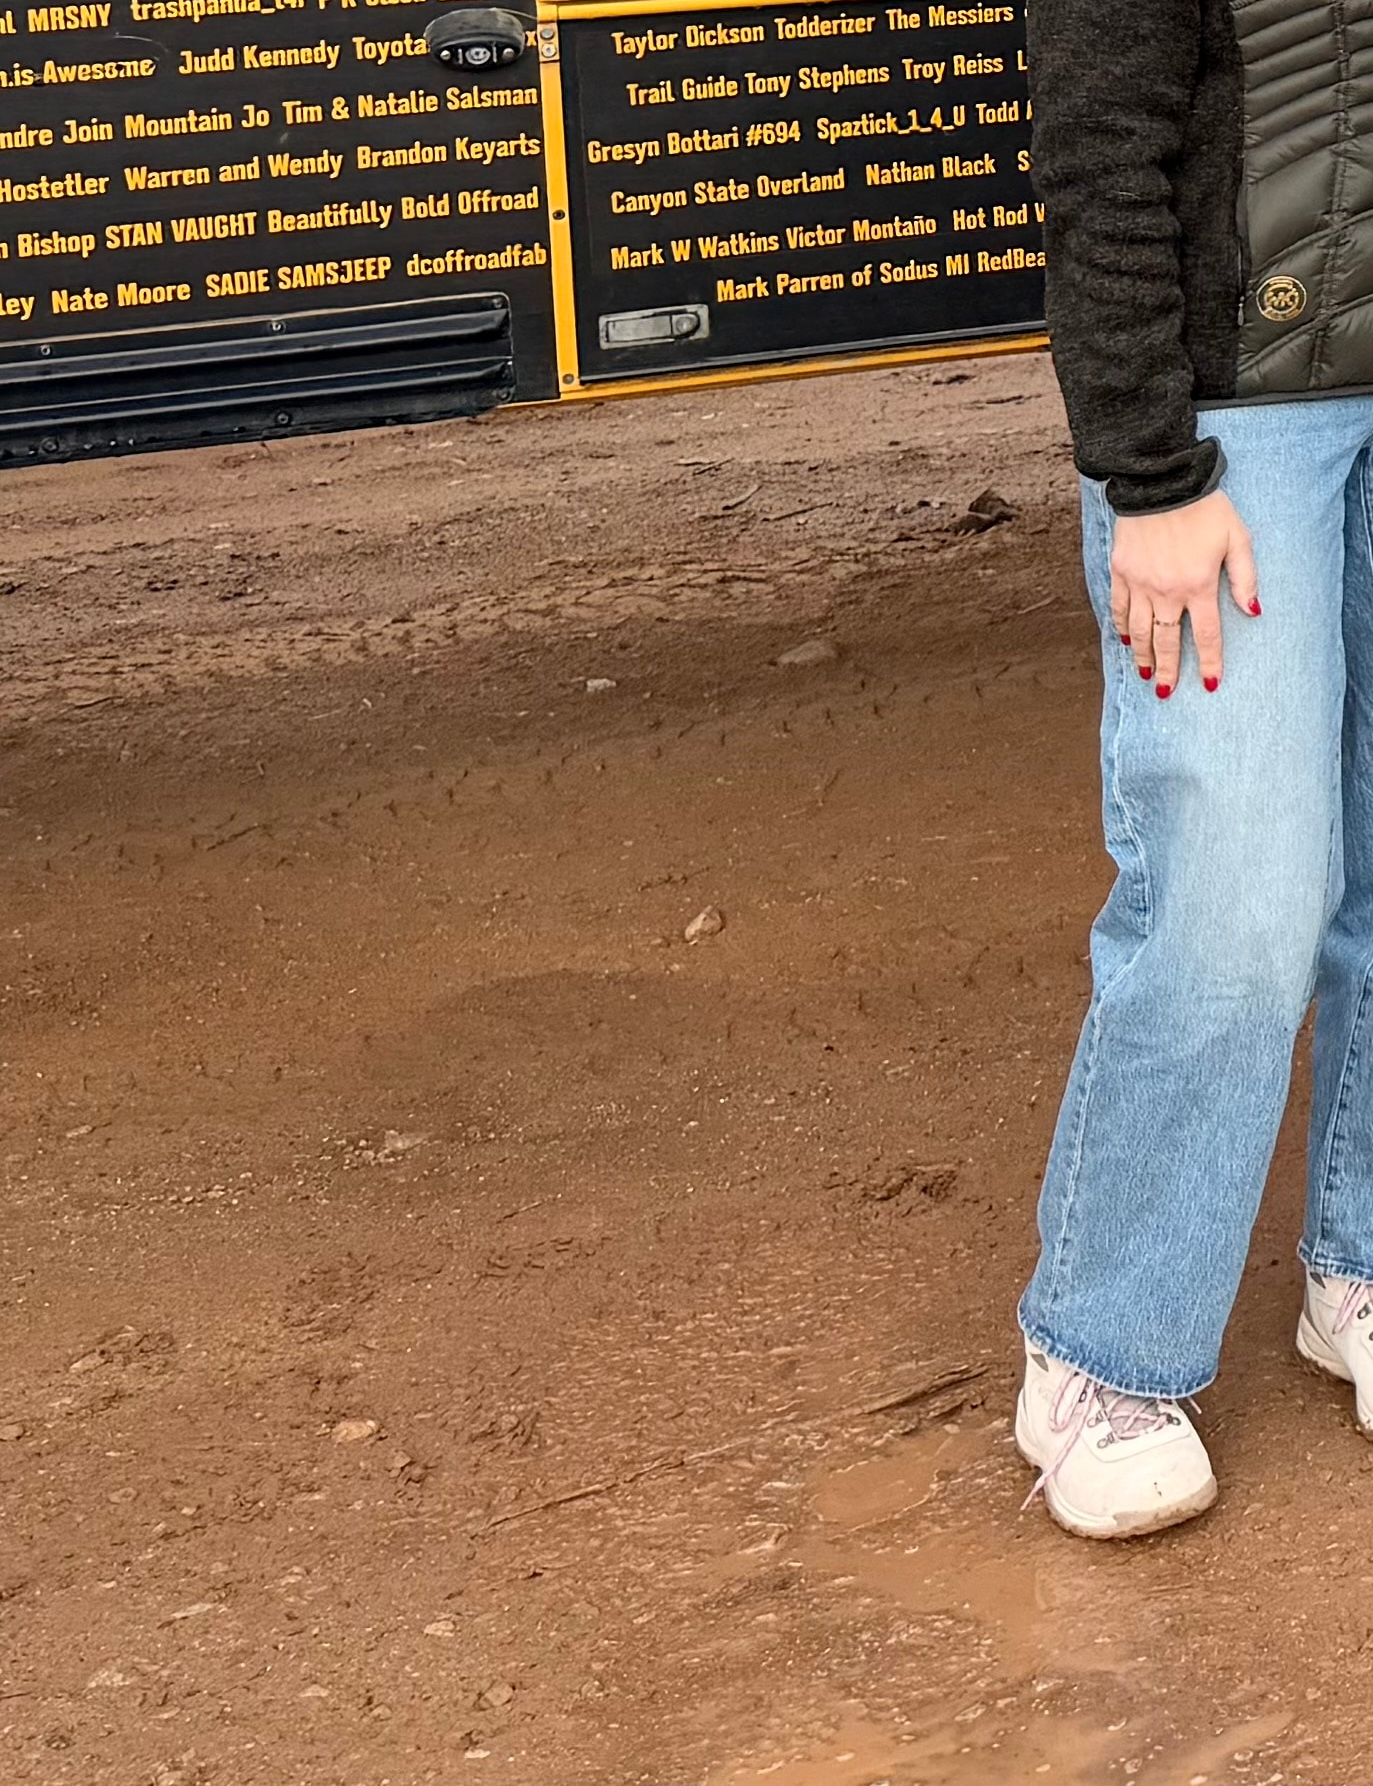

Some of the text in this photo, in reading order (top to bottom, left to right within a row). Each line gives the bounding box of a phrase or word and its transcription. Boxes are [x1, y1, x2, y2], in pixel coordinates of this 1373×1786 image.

[613, 9, 920, 58] Taylor Dickson The
[179, 47, 234, 74] Judd
[627, 59, 945, 105] Trail Guide Tony Troy
[63, 119, 113, 143] Join
[125, 109, 232, 138] Mountain
[358, 91, 438, 117] Natalie
[446, 87, 537, 110] Salsman
[977, 102, 1018, 124] Todd
[124, 142, 446, 190] Warren Wendy Brandon
[611, 162, 934, 215] Canyon State Overland Nathan
[18, 188, 538, 258] Bishop STAN VAUGHT Beautifully Bold Offroad
[611, 209, 986, 269] Mark Watkins Victor Hot
[52, 289, 108, 313] Nate
[118, 283, 190, 306] Moore
[206, 269, 269, 297] SADIE
[717, 274, 843, 302] Mark Parren
